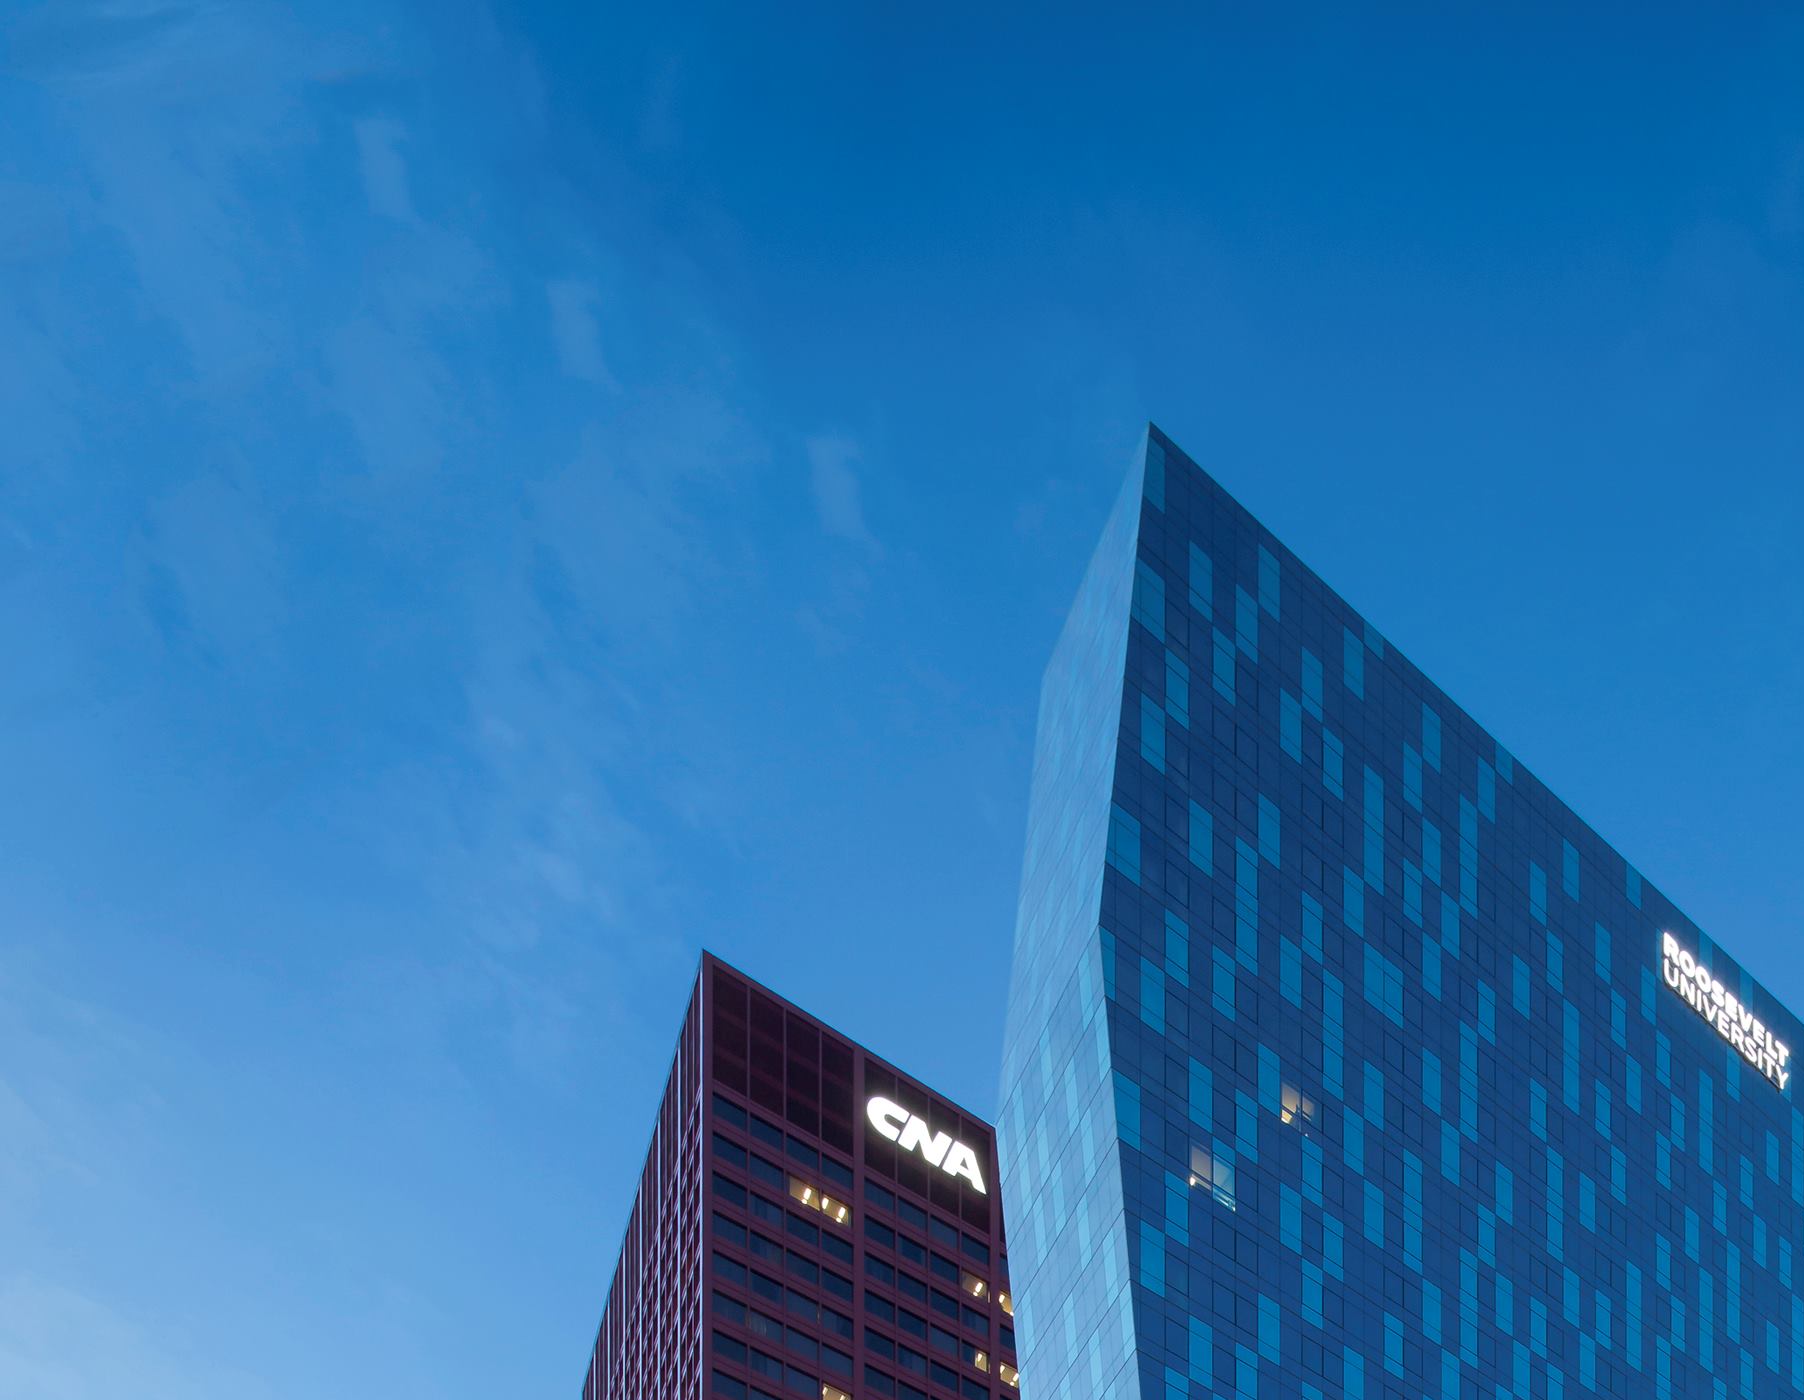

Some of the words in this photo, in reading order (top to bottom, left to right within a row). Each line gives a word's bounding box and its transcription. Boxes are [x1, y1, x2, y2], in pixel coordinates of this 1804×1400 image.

[1662, 932, 1790, 1066] ROOSEVELT
[1663, 957, 1789, 1091] UNIVERSITY
[866, 1096, 987, 1195] CNA
